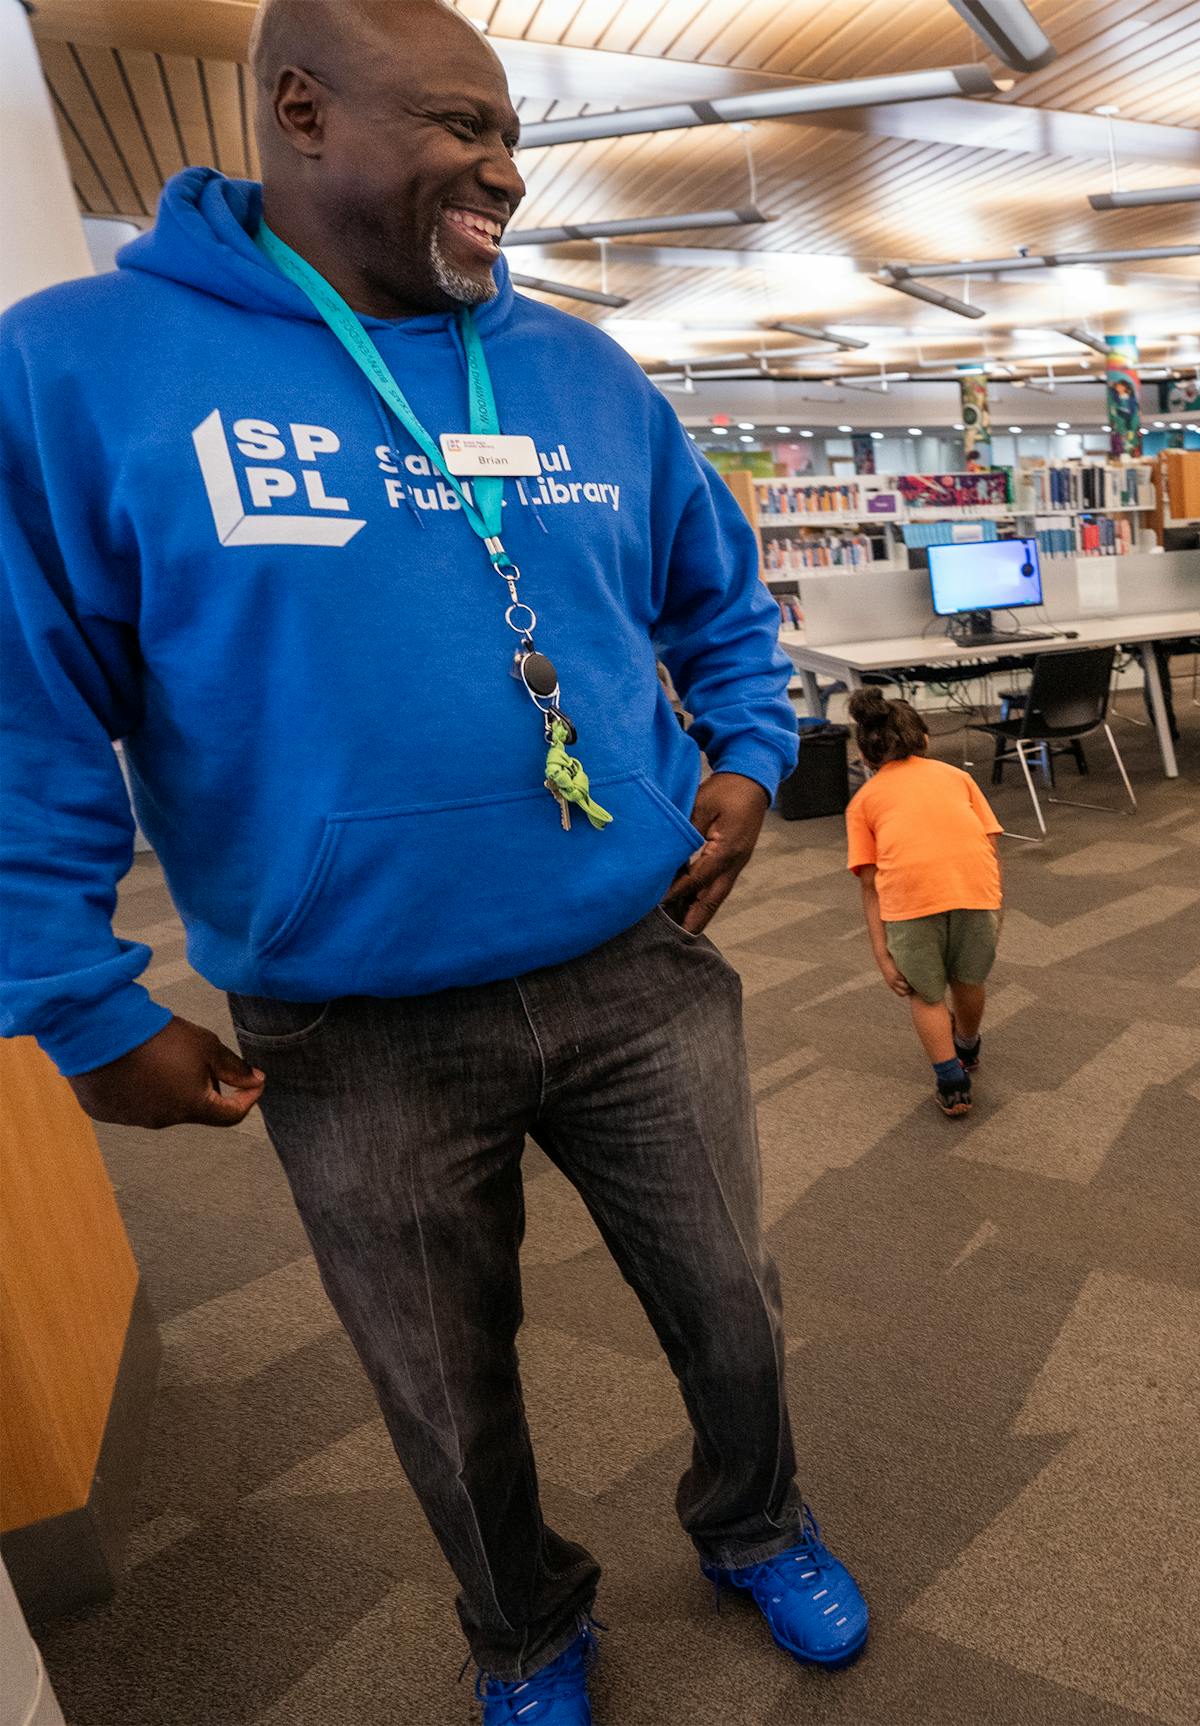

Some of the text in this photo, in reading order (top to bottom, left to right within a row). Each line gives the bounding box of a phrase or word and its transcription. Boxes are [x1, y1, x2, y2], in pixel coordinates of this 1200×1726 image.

[233, 418, 340, 462] SP
[478, 456, 509, 465] Brian
[538, 444, 572, 472] ul
[245, 466, 350, 512] PL
[384, 477, 620, 511] Publ Library
